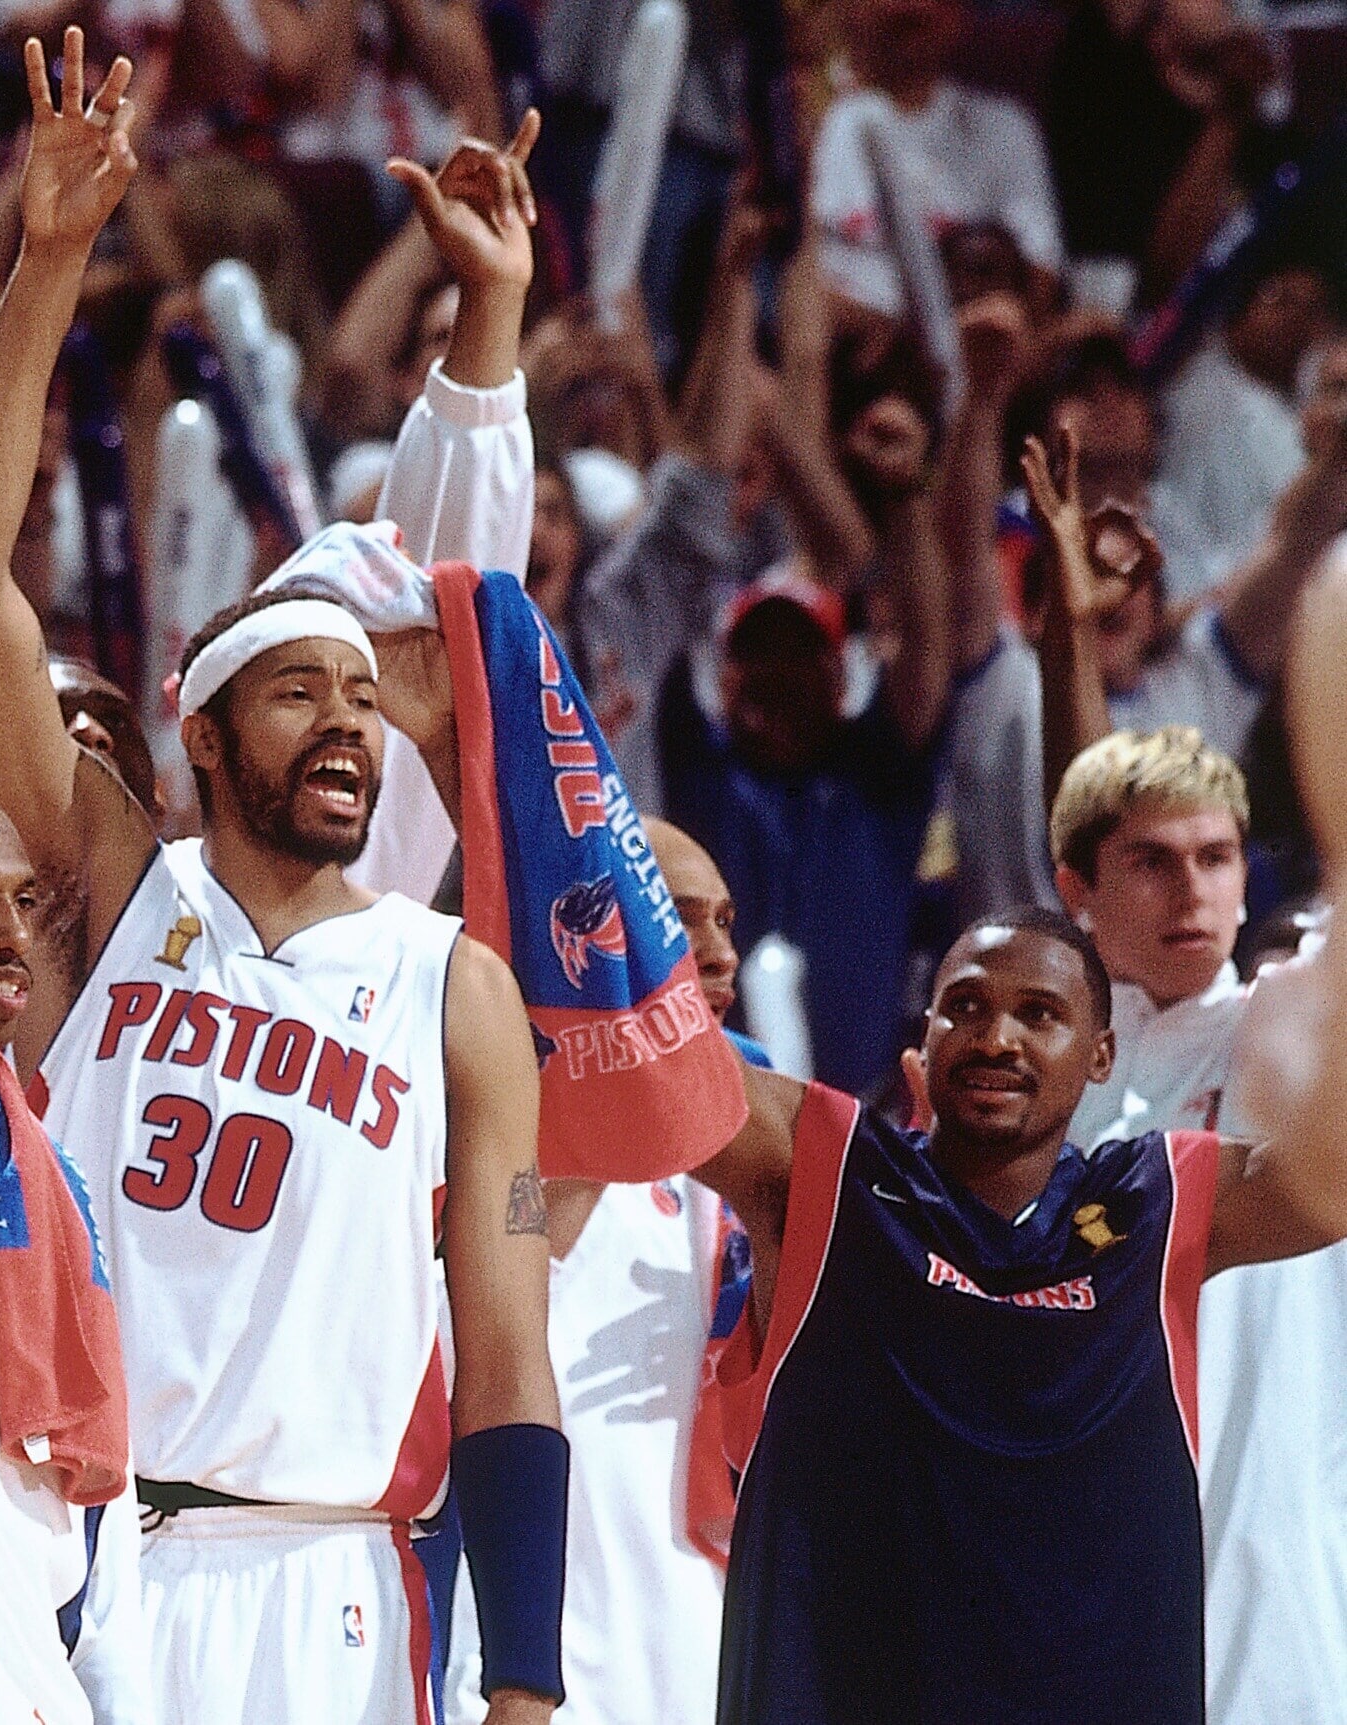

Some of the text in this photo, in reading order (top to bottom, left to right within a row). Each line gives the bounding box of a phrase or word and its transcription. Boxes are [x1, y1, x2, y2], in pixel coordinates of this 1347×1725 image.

[96, 981, 411, 1151] PISTONS
[558, 980, 709, 1081] PISTOS
[122, 1093, 294, 1233] 30
